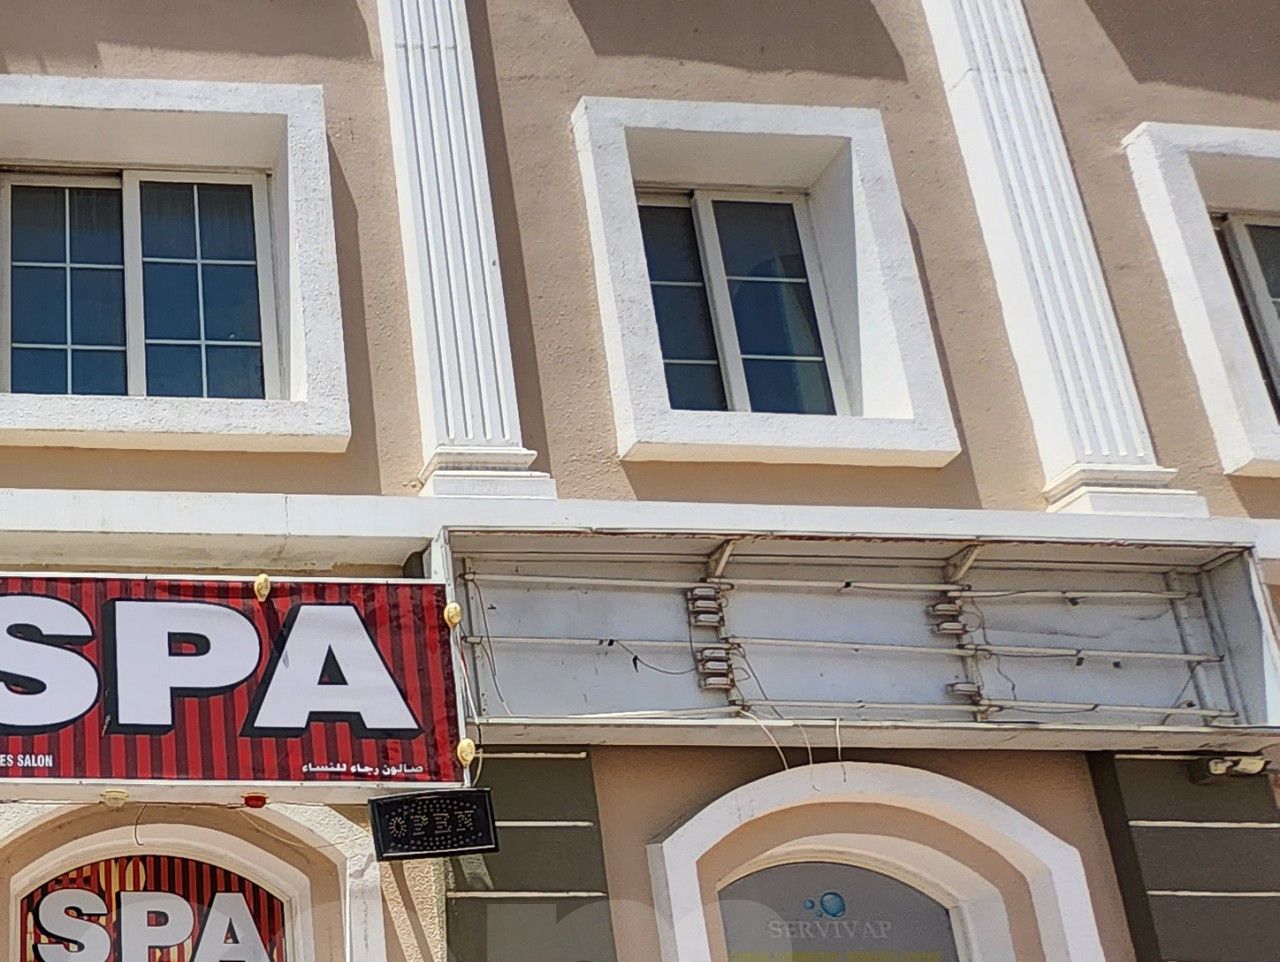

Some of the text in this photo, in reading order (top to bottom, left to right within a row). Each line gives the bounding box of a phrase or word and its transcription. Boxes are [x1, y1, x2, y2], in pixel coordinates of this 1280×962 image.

[17, 754, 53, 767] SALON
[301, 762, 424, 776] صالون رجاء للنساء
[768, 920, 892, 939] SERVIVAP
